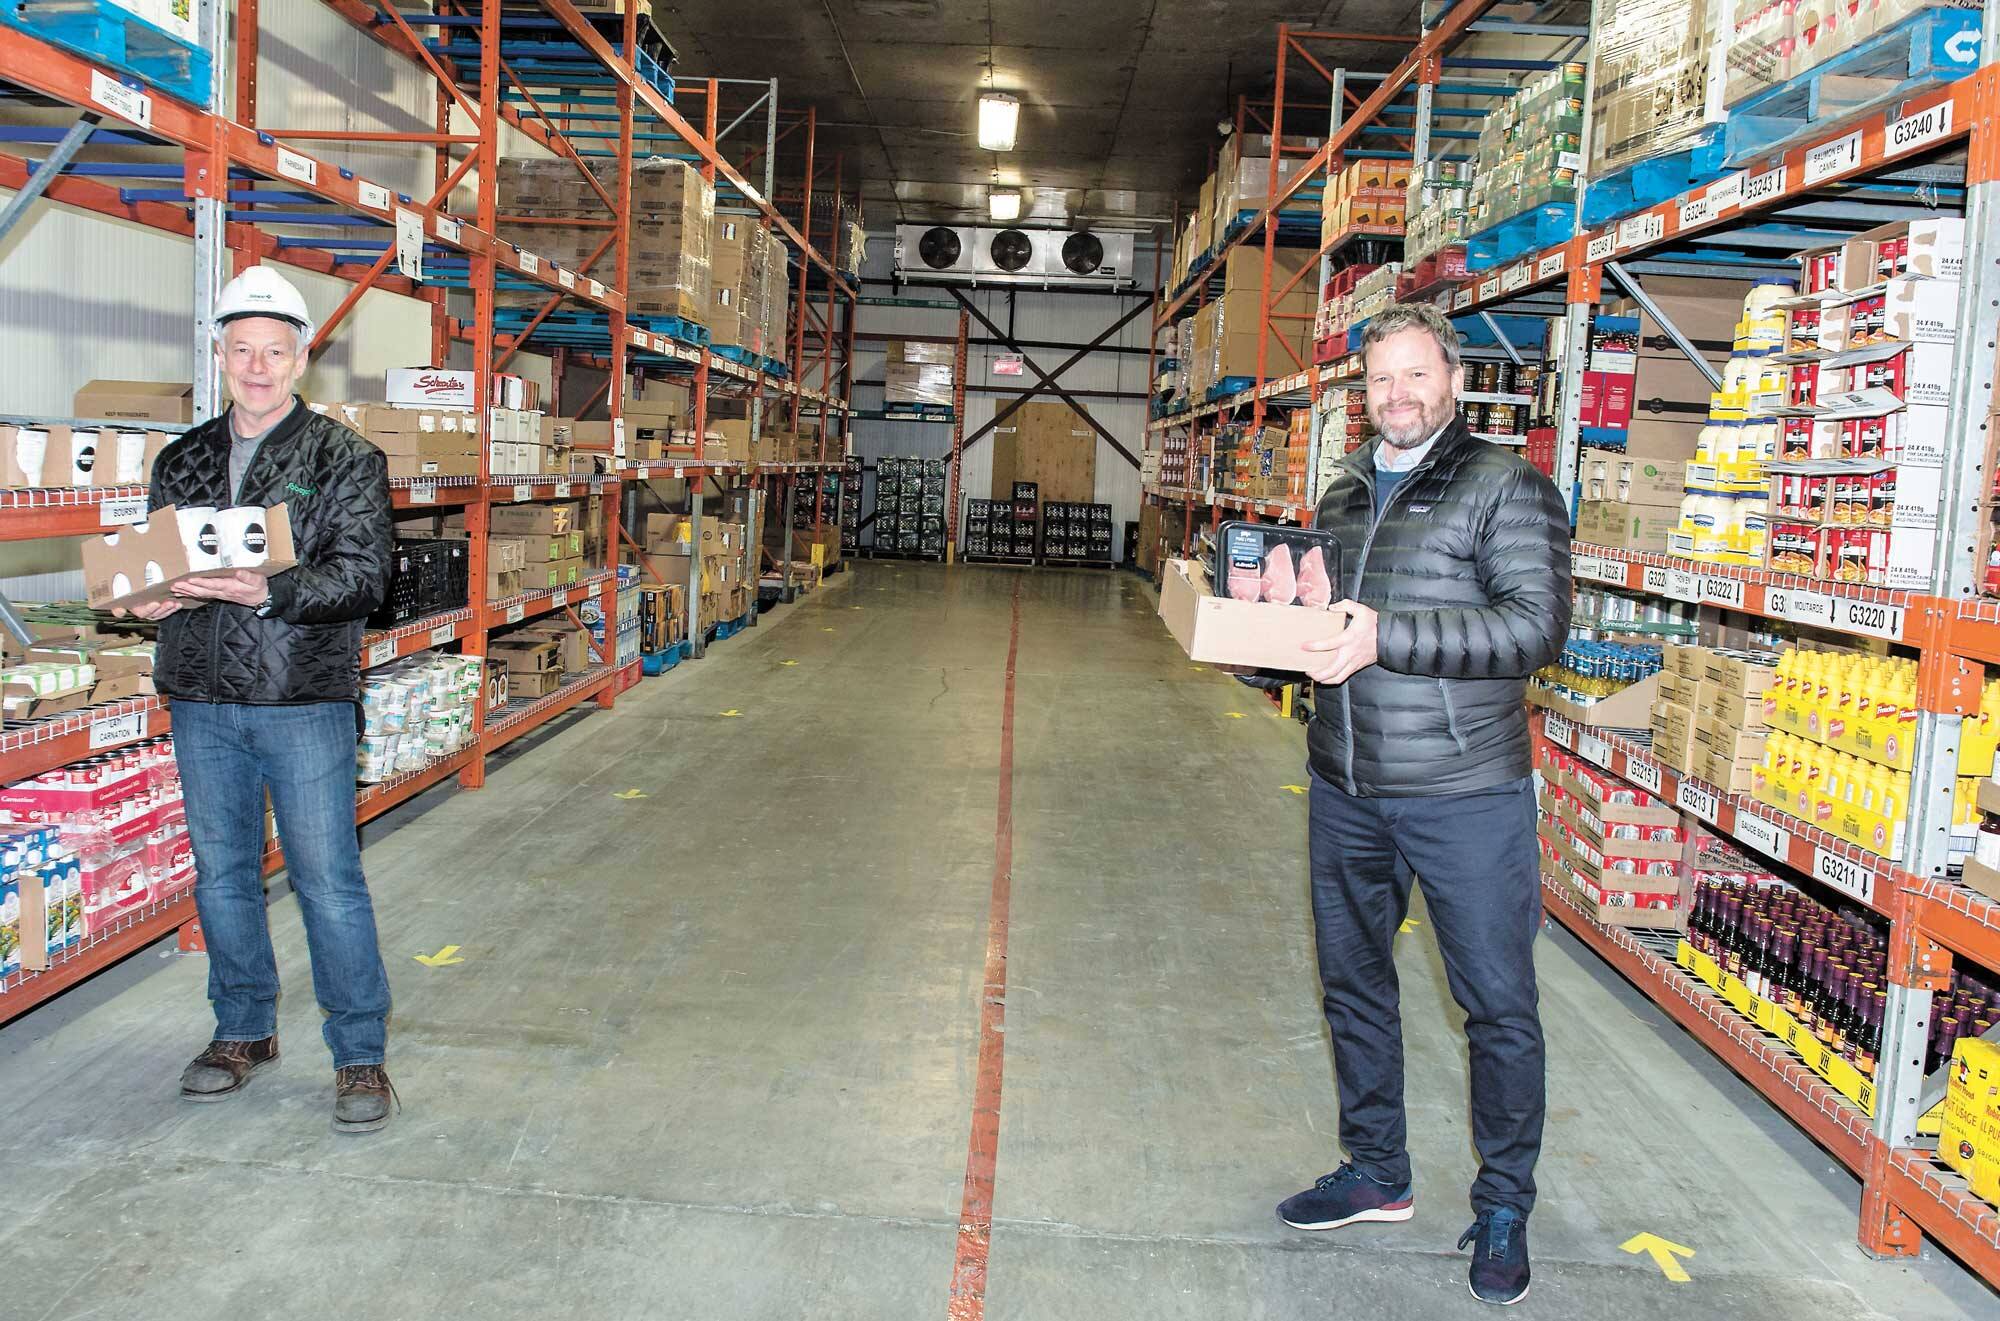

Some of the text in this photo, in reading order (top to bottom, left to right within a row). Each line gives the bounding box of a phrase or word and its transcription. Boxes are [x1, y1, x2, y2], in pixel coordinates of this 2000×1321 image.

[1894, 113, 1933, 146] G3240
[1819, 159, 1837, 174] CANNE
[1684, 201, 1707, 222] G3244
[1489, 411, 1505, 419] VAN
[113, 506, 137, 517] BOURSIN
[1648, 570, 1667, 588] G322
[1706, 579, 1732, 600] G3222
[1771, 593, 1786, 613] G3
[1794, 601, 1823, 614] MOUTARDE
[1602, 618, 1643, 630] Green Giant
[1849, 604, 1885, 629] G3220
[100, 729, 131, 741] CARNATION
[1631, 760, 1652, 783] G3215
[1682, 787, 1706, 812] G3213
[1741, 820, 1770, 841] SAUCE SOYA
[1822, 855, 1856, 888] G3211
[1718, 972, 1727, 988] VH
[1749, 998, 1759, 1014] VH
[1788, 1025, 1797, 1041] VH
[1820, 1051, 1829, 1069] VH
[1860, 1086, 1870, 1104] VH
[1955, 1104, 1978, 1127] USAGE
